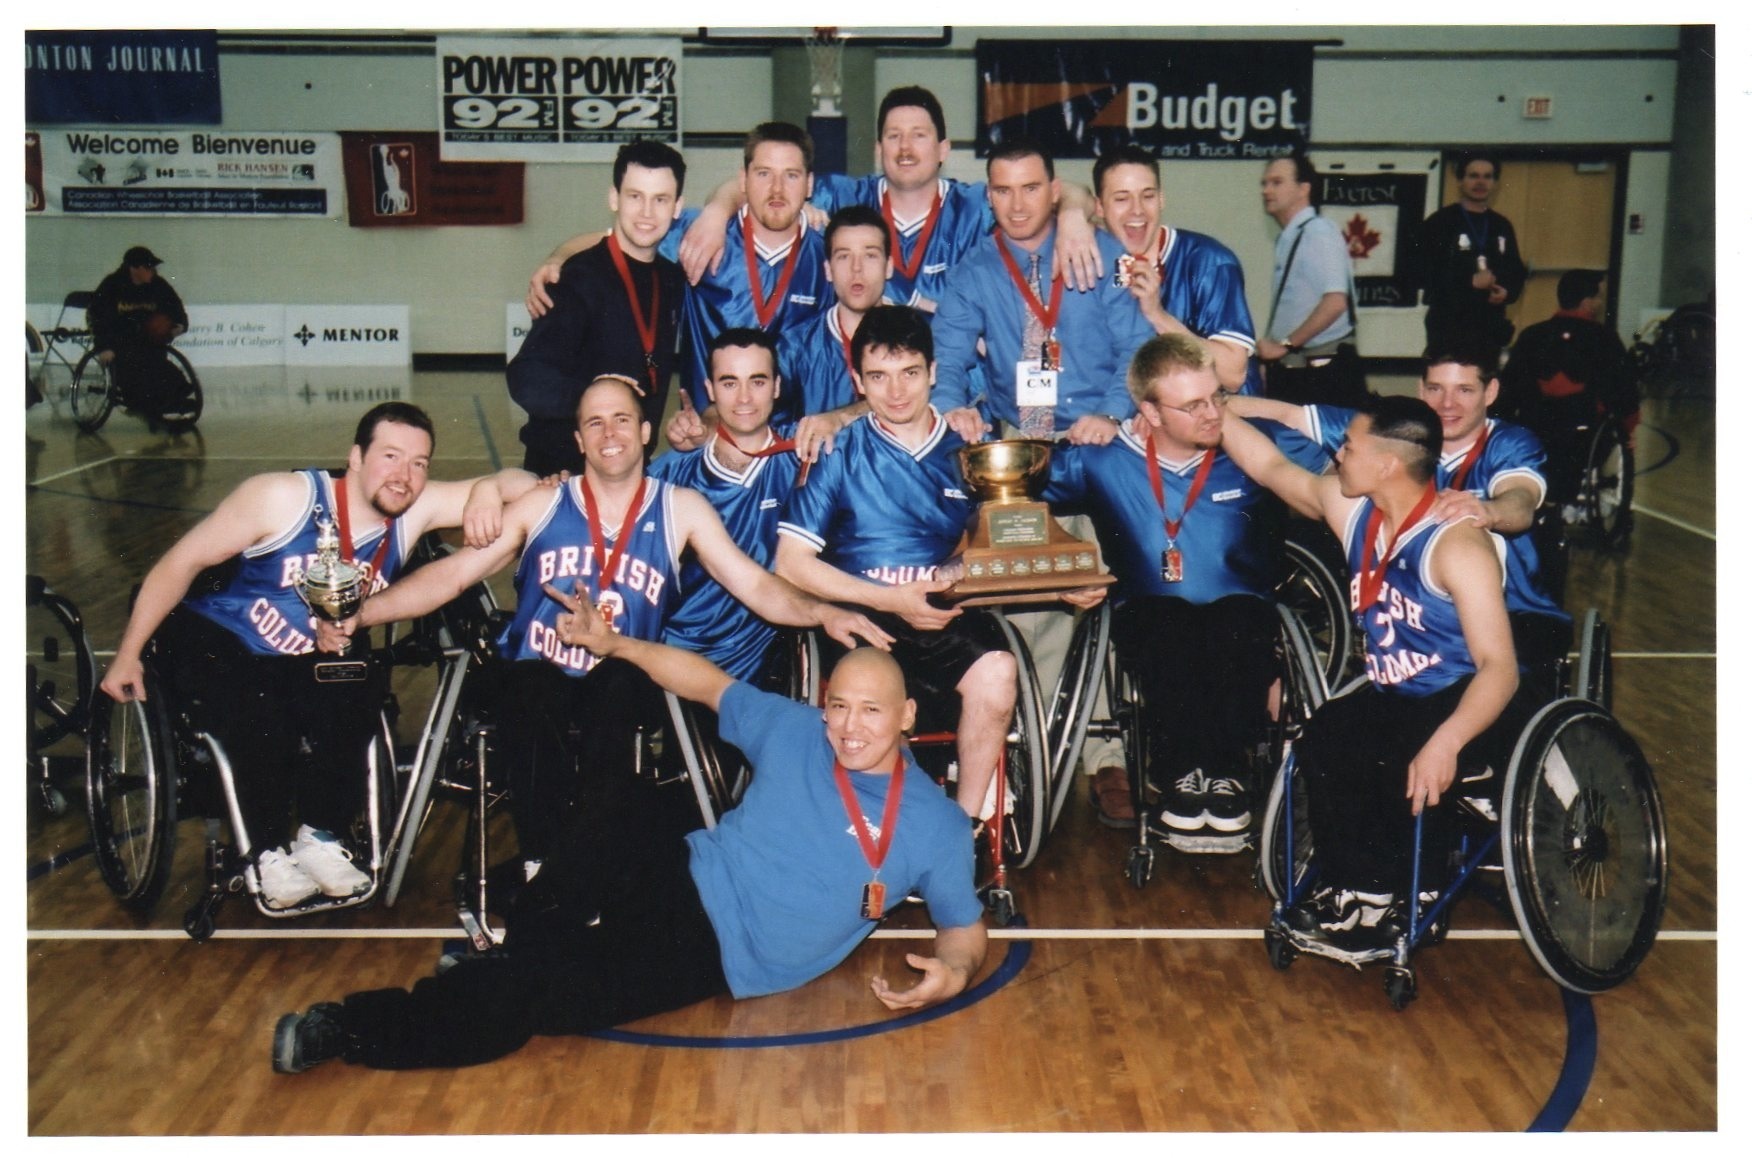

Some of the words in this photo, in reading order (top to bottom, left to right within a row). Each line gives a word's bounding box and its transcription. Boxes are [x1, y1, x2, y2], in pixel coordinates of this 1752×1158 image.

[107, 46, 205, 72] JOURNAL
[443, 55, 557, 94] POWER
[563, 56, 676, 95] POWER
[452, 98, 540, 129] 92
[543, 100, 554, 127] FM
[571, 98, 660, 129] 92
[662, 100, 674, 127] FM
[1126, 82, 1298, 141] Budget
[66, 134, 180, 155] Welcome
[192, 134, 316, 155] Bienvenue
[1161, 143, 1191, 157] and
[1197, 142, 1236, 157] Truck
[217, 163, 241, 173] RICK
[245, 164, 288, 173] HANSEN
[323, 328, 399, 342] MENTOR
[1375, 611, 1396, 648] 7
